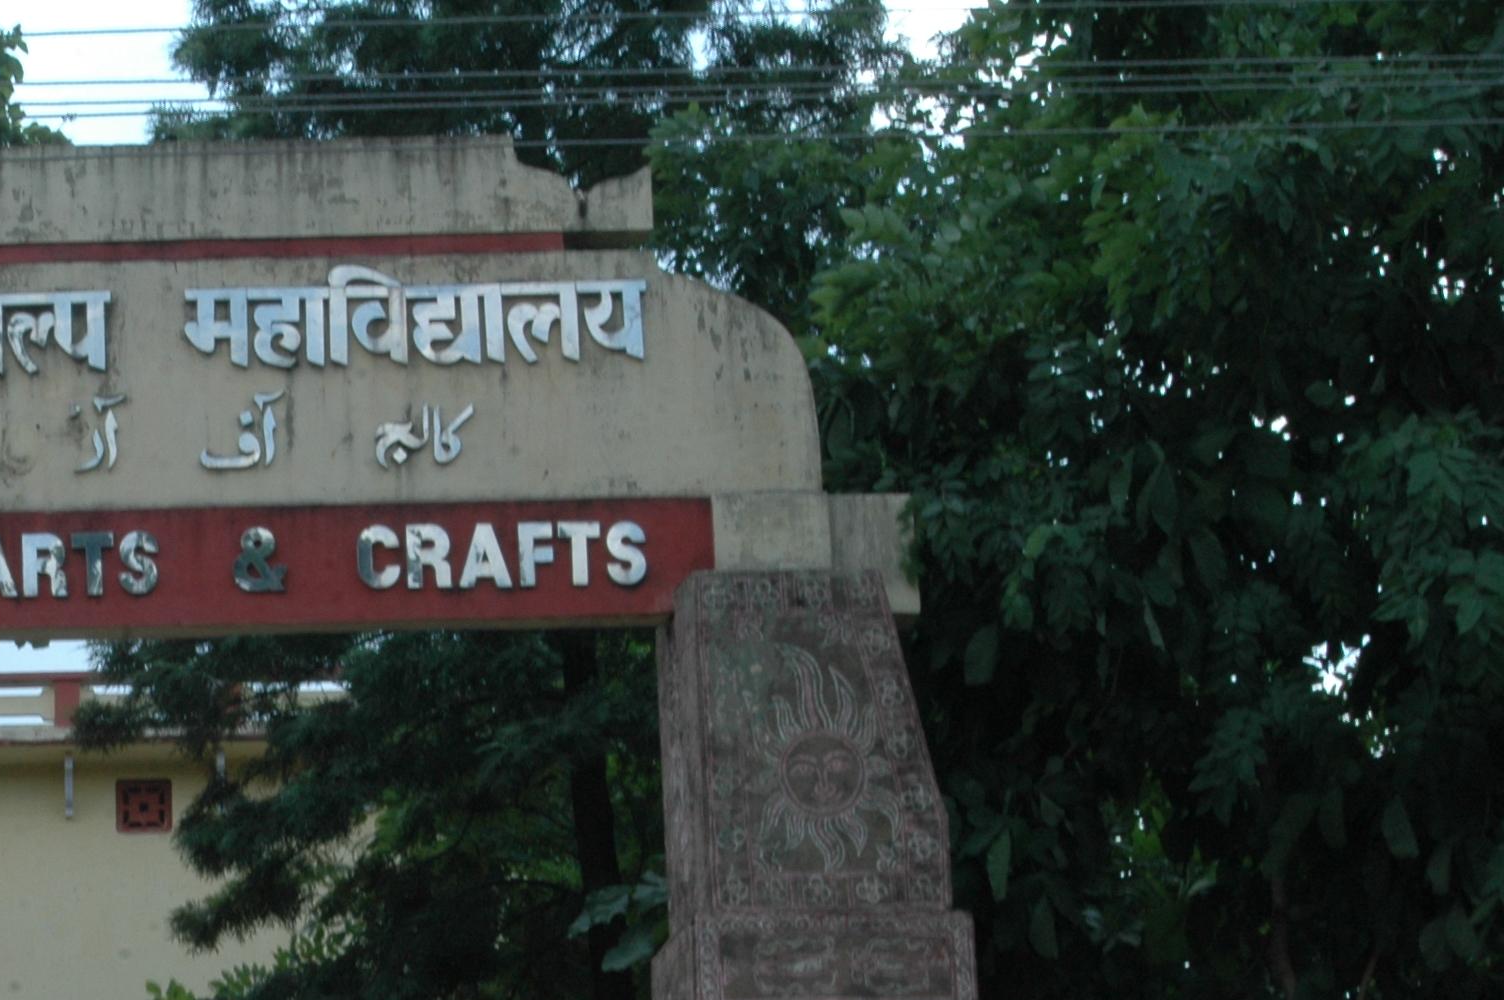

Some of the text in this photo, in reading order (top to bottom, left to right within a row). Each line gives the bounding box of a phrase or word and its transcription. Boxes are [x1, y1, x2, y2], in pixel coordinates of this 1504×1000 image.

[183, 264, 648, 369] महाविद्यालय
[199, 389, 287, 471] آف
[232, 526, 287, 594] &
[356, 520, 649, 590] CRAFTS
